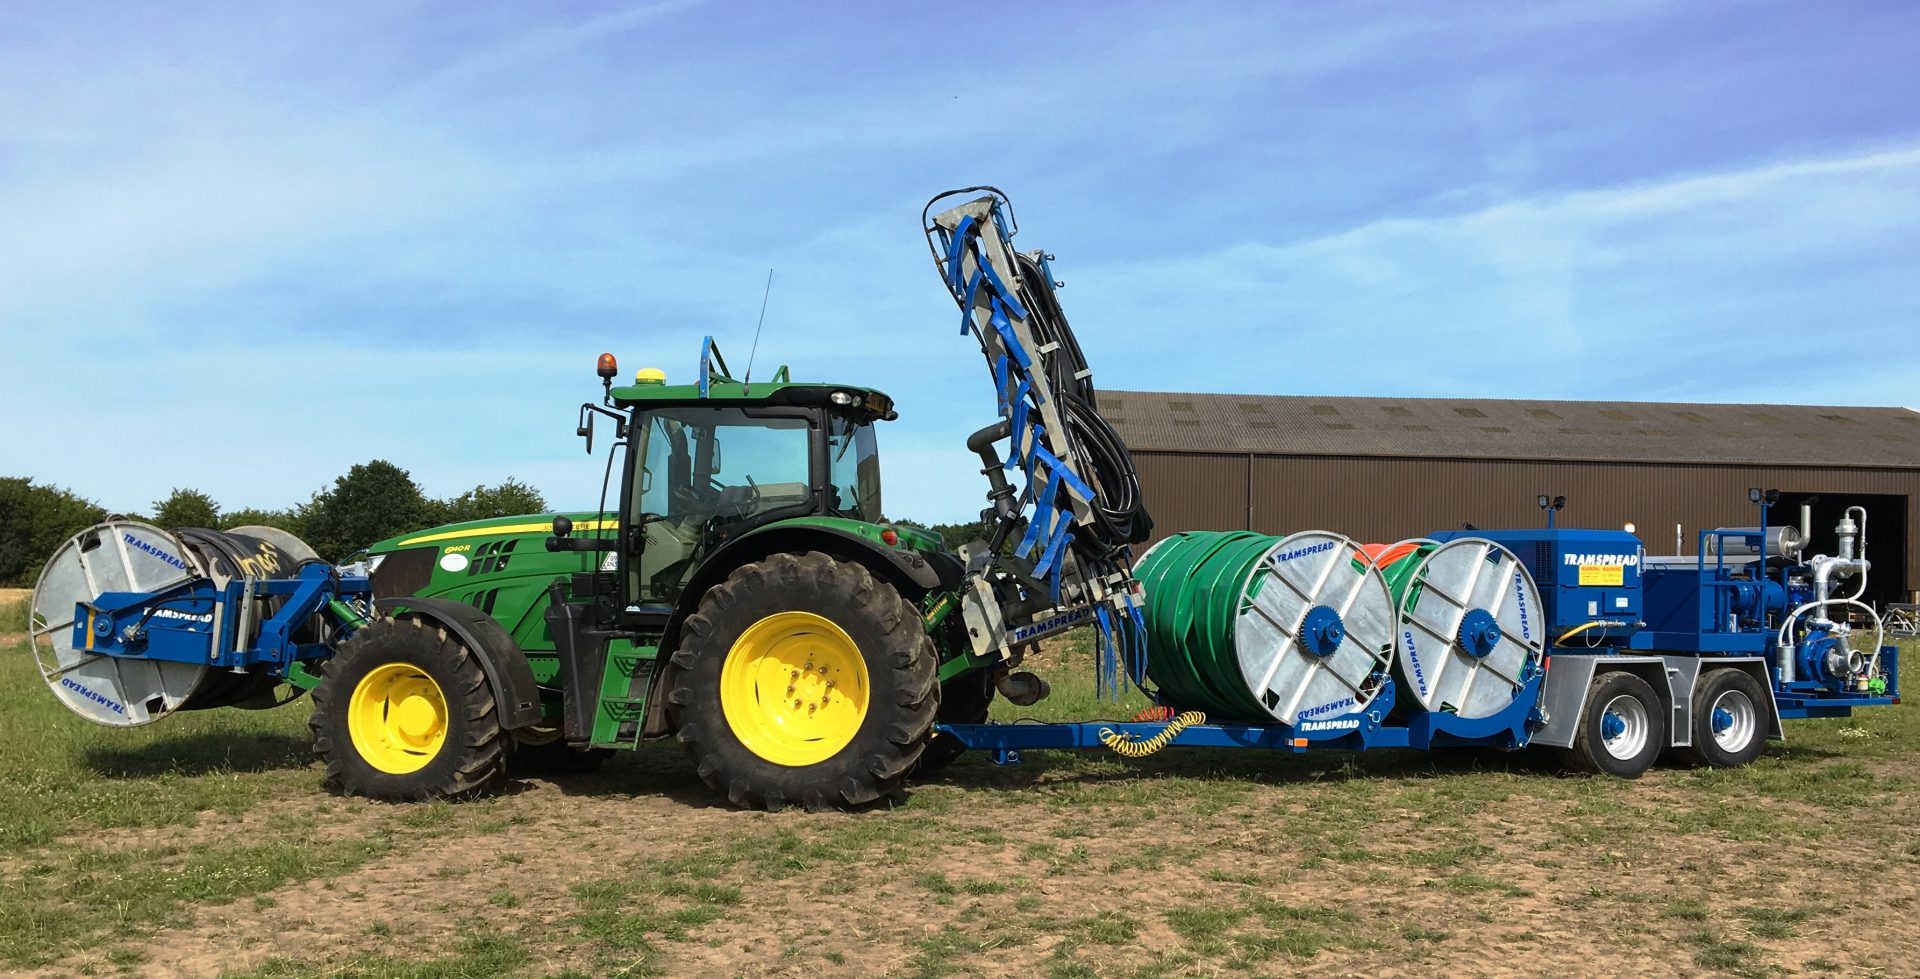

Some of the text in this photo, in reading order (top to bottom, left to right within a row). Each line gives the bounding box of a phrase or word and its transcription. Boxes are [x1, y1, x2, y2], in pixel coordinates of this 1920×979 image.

[123, 533, 187, 570] TRAMSPREAD
[1277, 541, 1334, 563] TRAMSPREAD
[1564, 553, 1638, 566] TRAMSPREAD
[143, 606, 213, 623] TAMSPREAD
[1515, 572, 1530, 639] TRAMSPREAD
[1015, 608, 1090, 641] TRAMSPREAD
[1404, 631, 1428, 697] TRAMSPREAD
[62, 678, 124, 714] TRAMSPREAD
[1297, 697, 1355, 720] TRAMSPREAD
[1301, 720, 1360, 731] TRAMSPREAD
